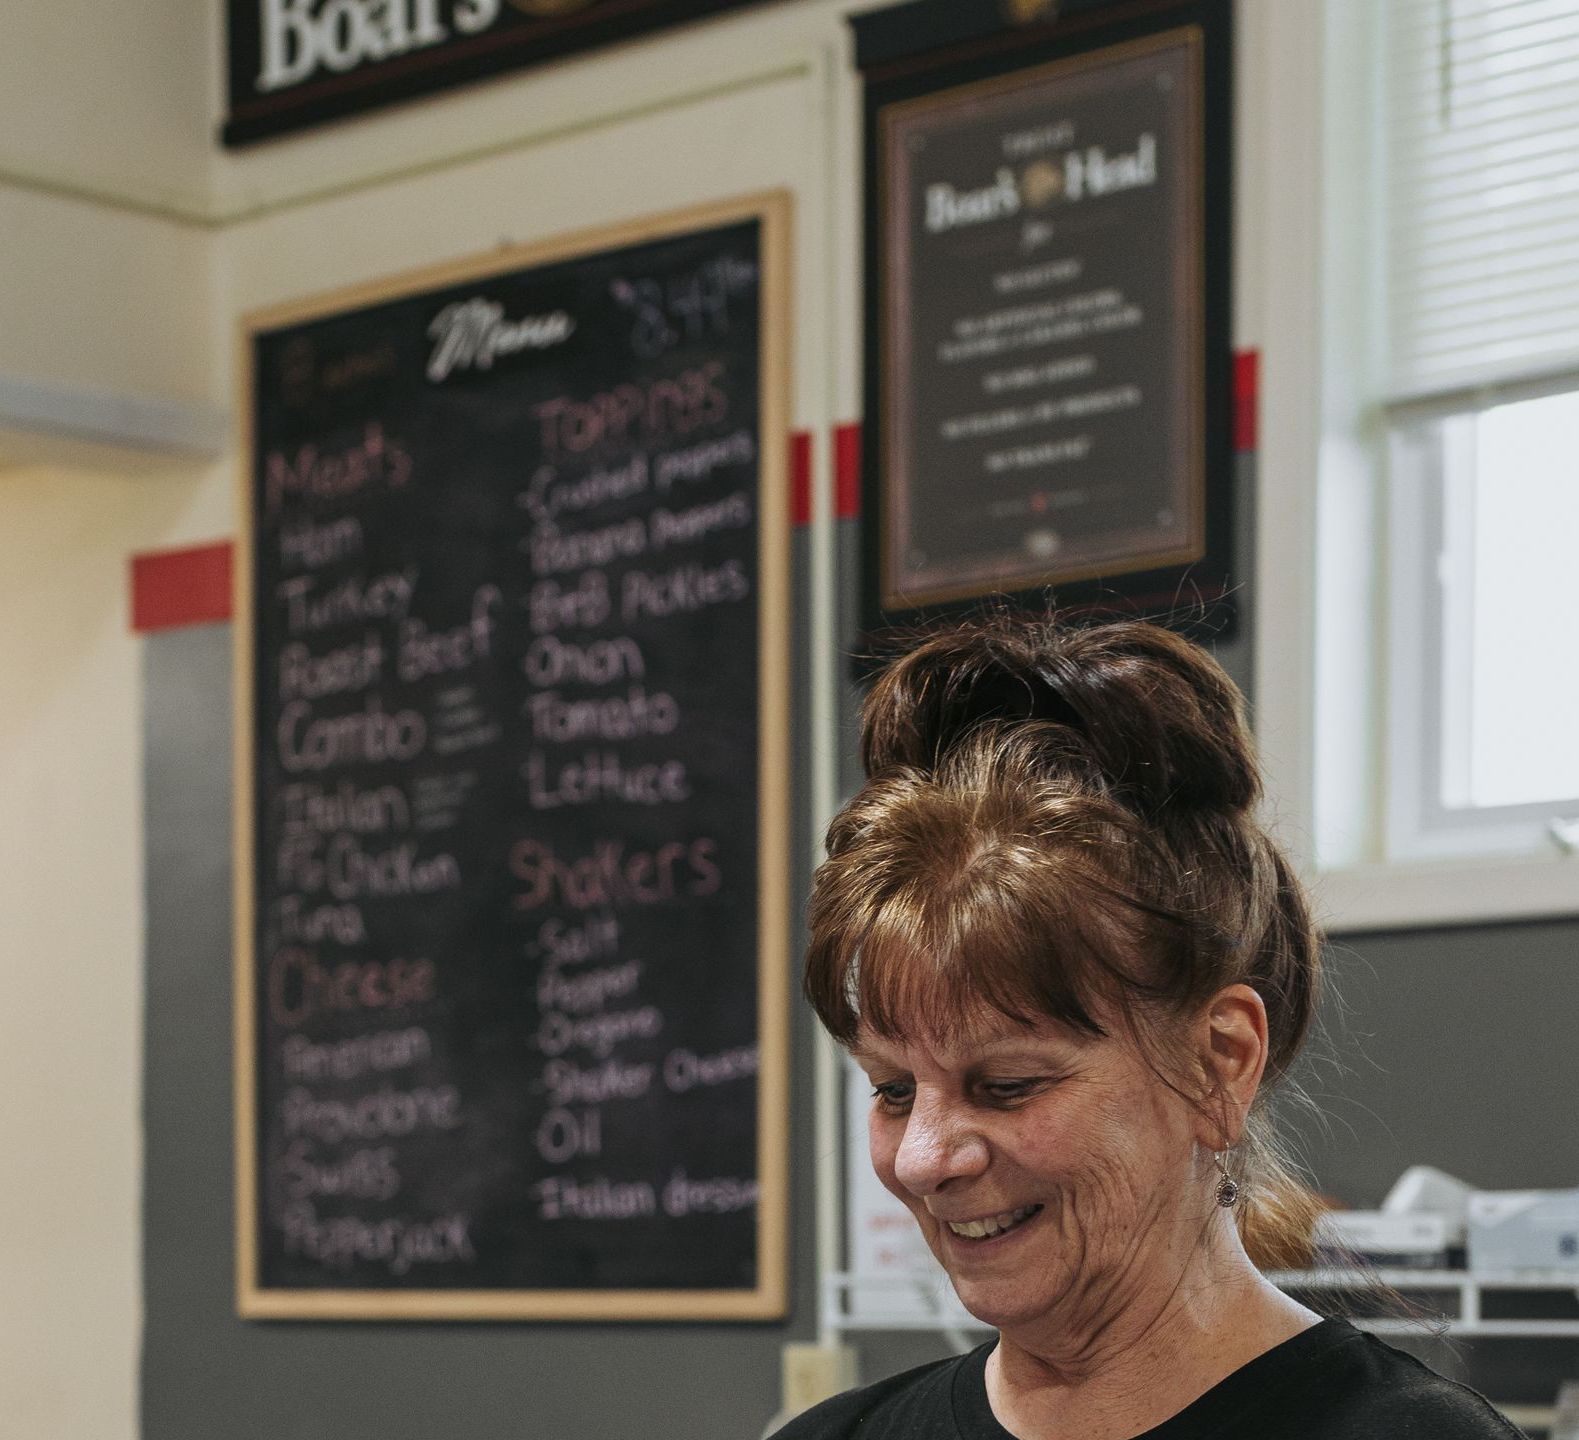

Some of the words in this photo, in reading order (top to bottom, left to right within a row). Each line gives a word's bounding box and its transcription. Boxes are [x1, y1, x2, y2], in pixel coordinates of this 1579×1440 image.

[254, 0, 500, 91] Boars
[1064, 132, 1157, 200] Head
[426, 299, 574, 381] Menu
[277, 567, 418, 629] Turkey
[279, 634, 382, 699] Roast
[401, 586, 499, 682] Beef
[277, 701, 427, 771] Combo
[527, 688, 679, 741] Tomato
[529, 749, 688, 810] Lettuce
[509, 838, 722, 908] Shakers
[270, 947, 435, 1026] Cheese
[538, 1107, 600, 1162] Oil
[540, 1176, 655, 1220] Italian
